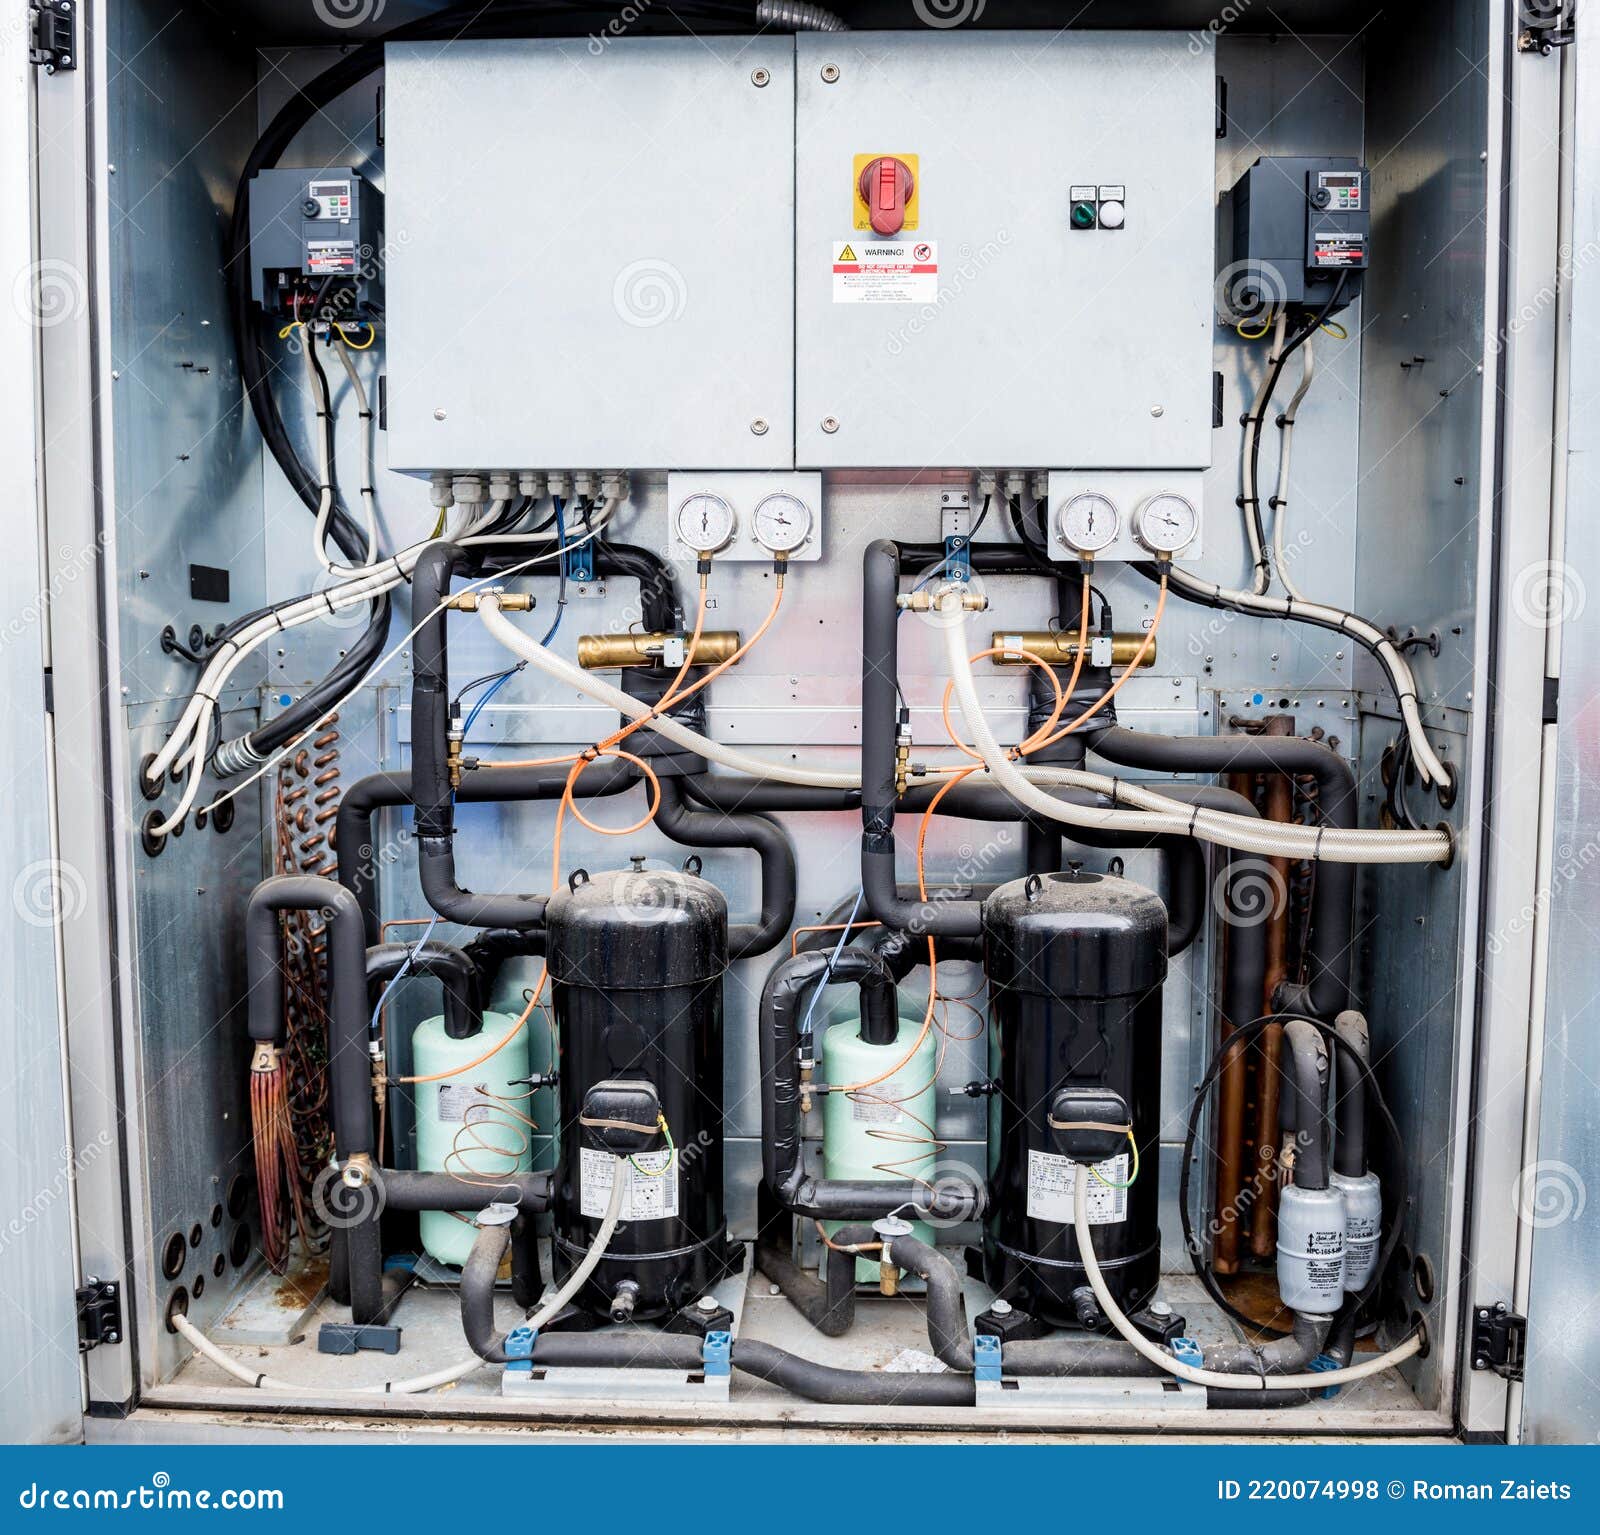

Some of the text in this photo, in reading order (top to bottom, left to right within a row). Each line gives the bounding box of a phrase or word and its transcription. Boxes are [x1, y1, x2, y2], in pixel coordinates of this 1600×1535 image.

[864, 248, 905, 257] WARNING!
[705, 599, 718, 609] C1
[1142, 619, 1154, 629] C2
[259, 1053, 272, 1068] 2
